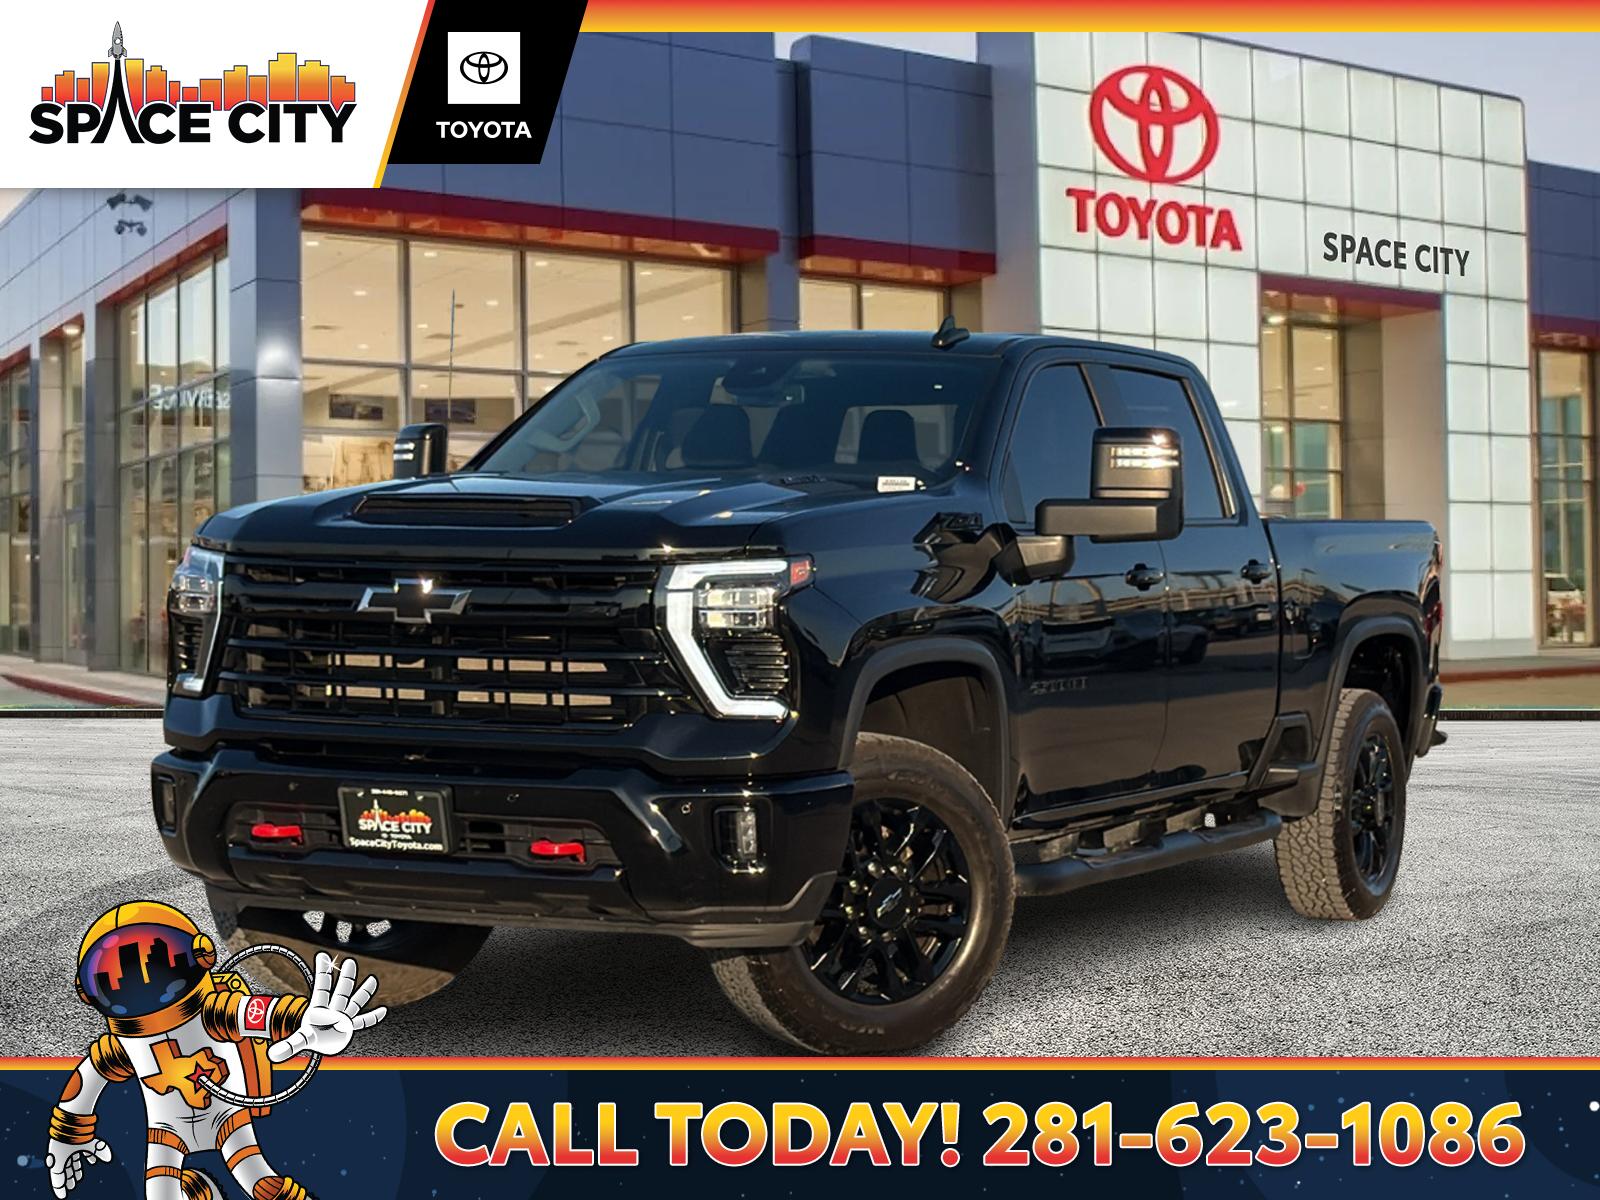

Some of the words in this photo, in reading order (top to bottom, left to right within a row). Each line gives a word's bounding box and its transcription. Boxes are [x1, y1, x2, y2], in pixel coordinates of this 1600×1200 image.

[1066, 188, 1242, 251] TOYOTA
[1323, 232, 1407, 270] SPACE
[1414, 244, 1470, 277] CITY
[401, 822, 432, 834] CITY
[349, 837, 443, 851] SpaceCityToyota.com
